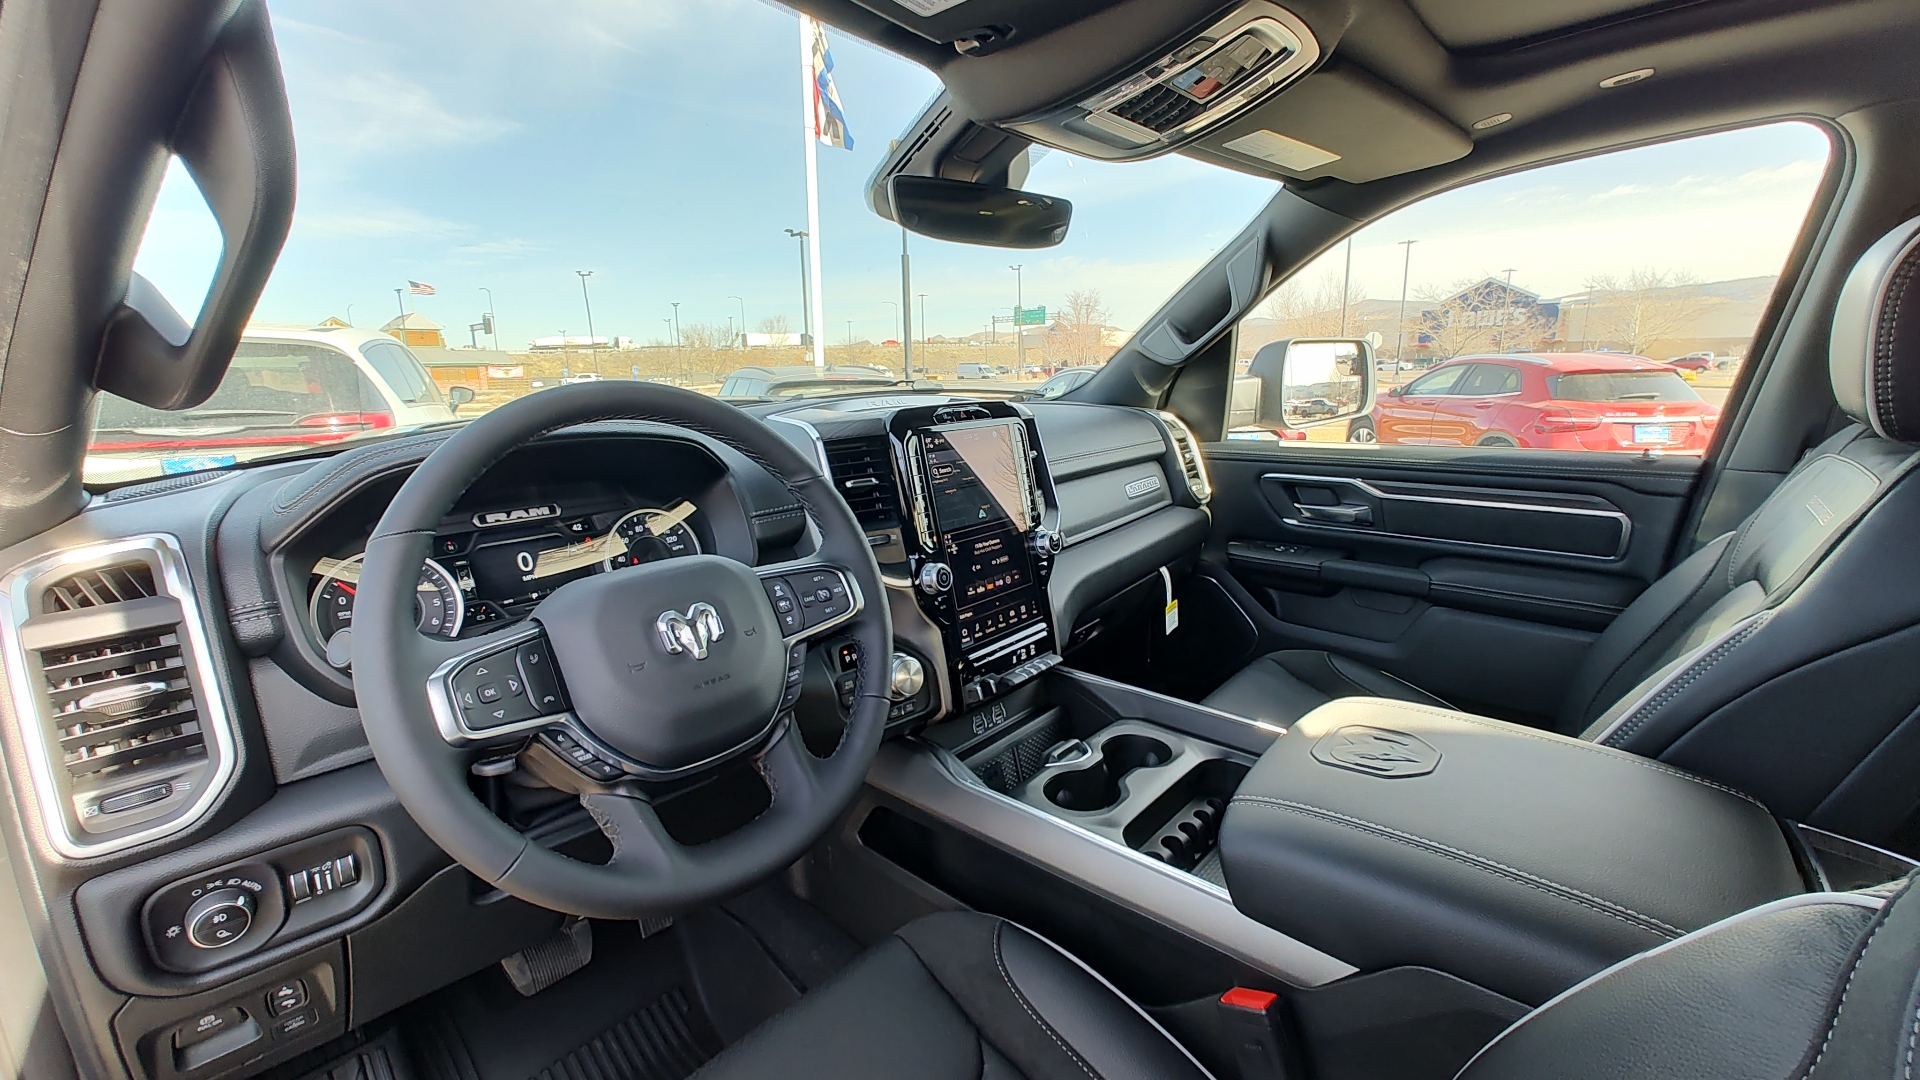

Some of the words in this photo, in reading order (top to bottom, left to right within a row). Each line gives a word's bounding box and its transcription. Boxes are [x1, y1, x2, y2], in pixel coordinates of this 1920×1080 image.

[486, 506, 550, 523] RAM
[571, 523, 583, 531] 42
[634, 524, 644, 533] 80
[665, 535, 678, 543] 120
[516, 551, 534, 572] 0
[338, 596, 347, 605] 0
[531, 592, 539, 600] P
[433, 598, 441, 606] 5
[431, 617, 439, 625] 6
[484, 687, 496, 697] OK
[242, 879, 262, 892] AUTO
